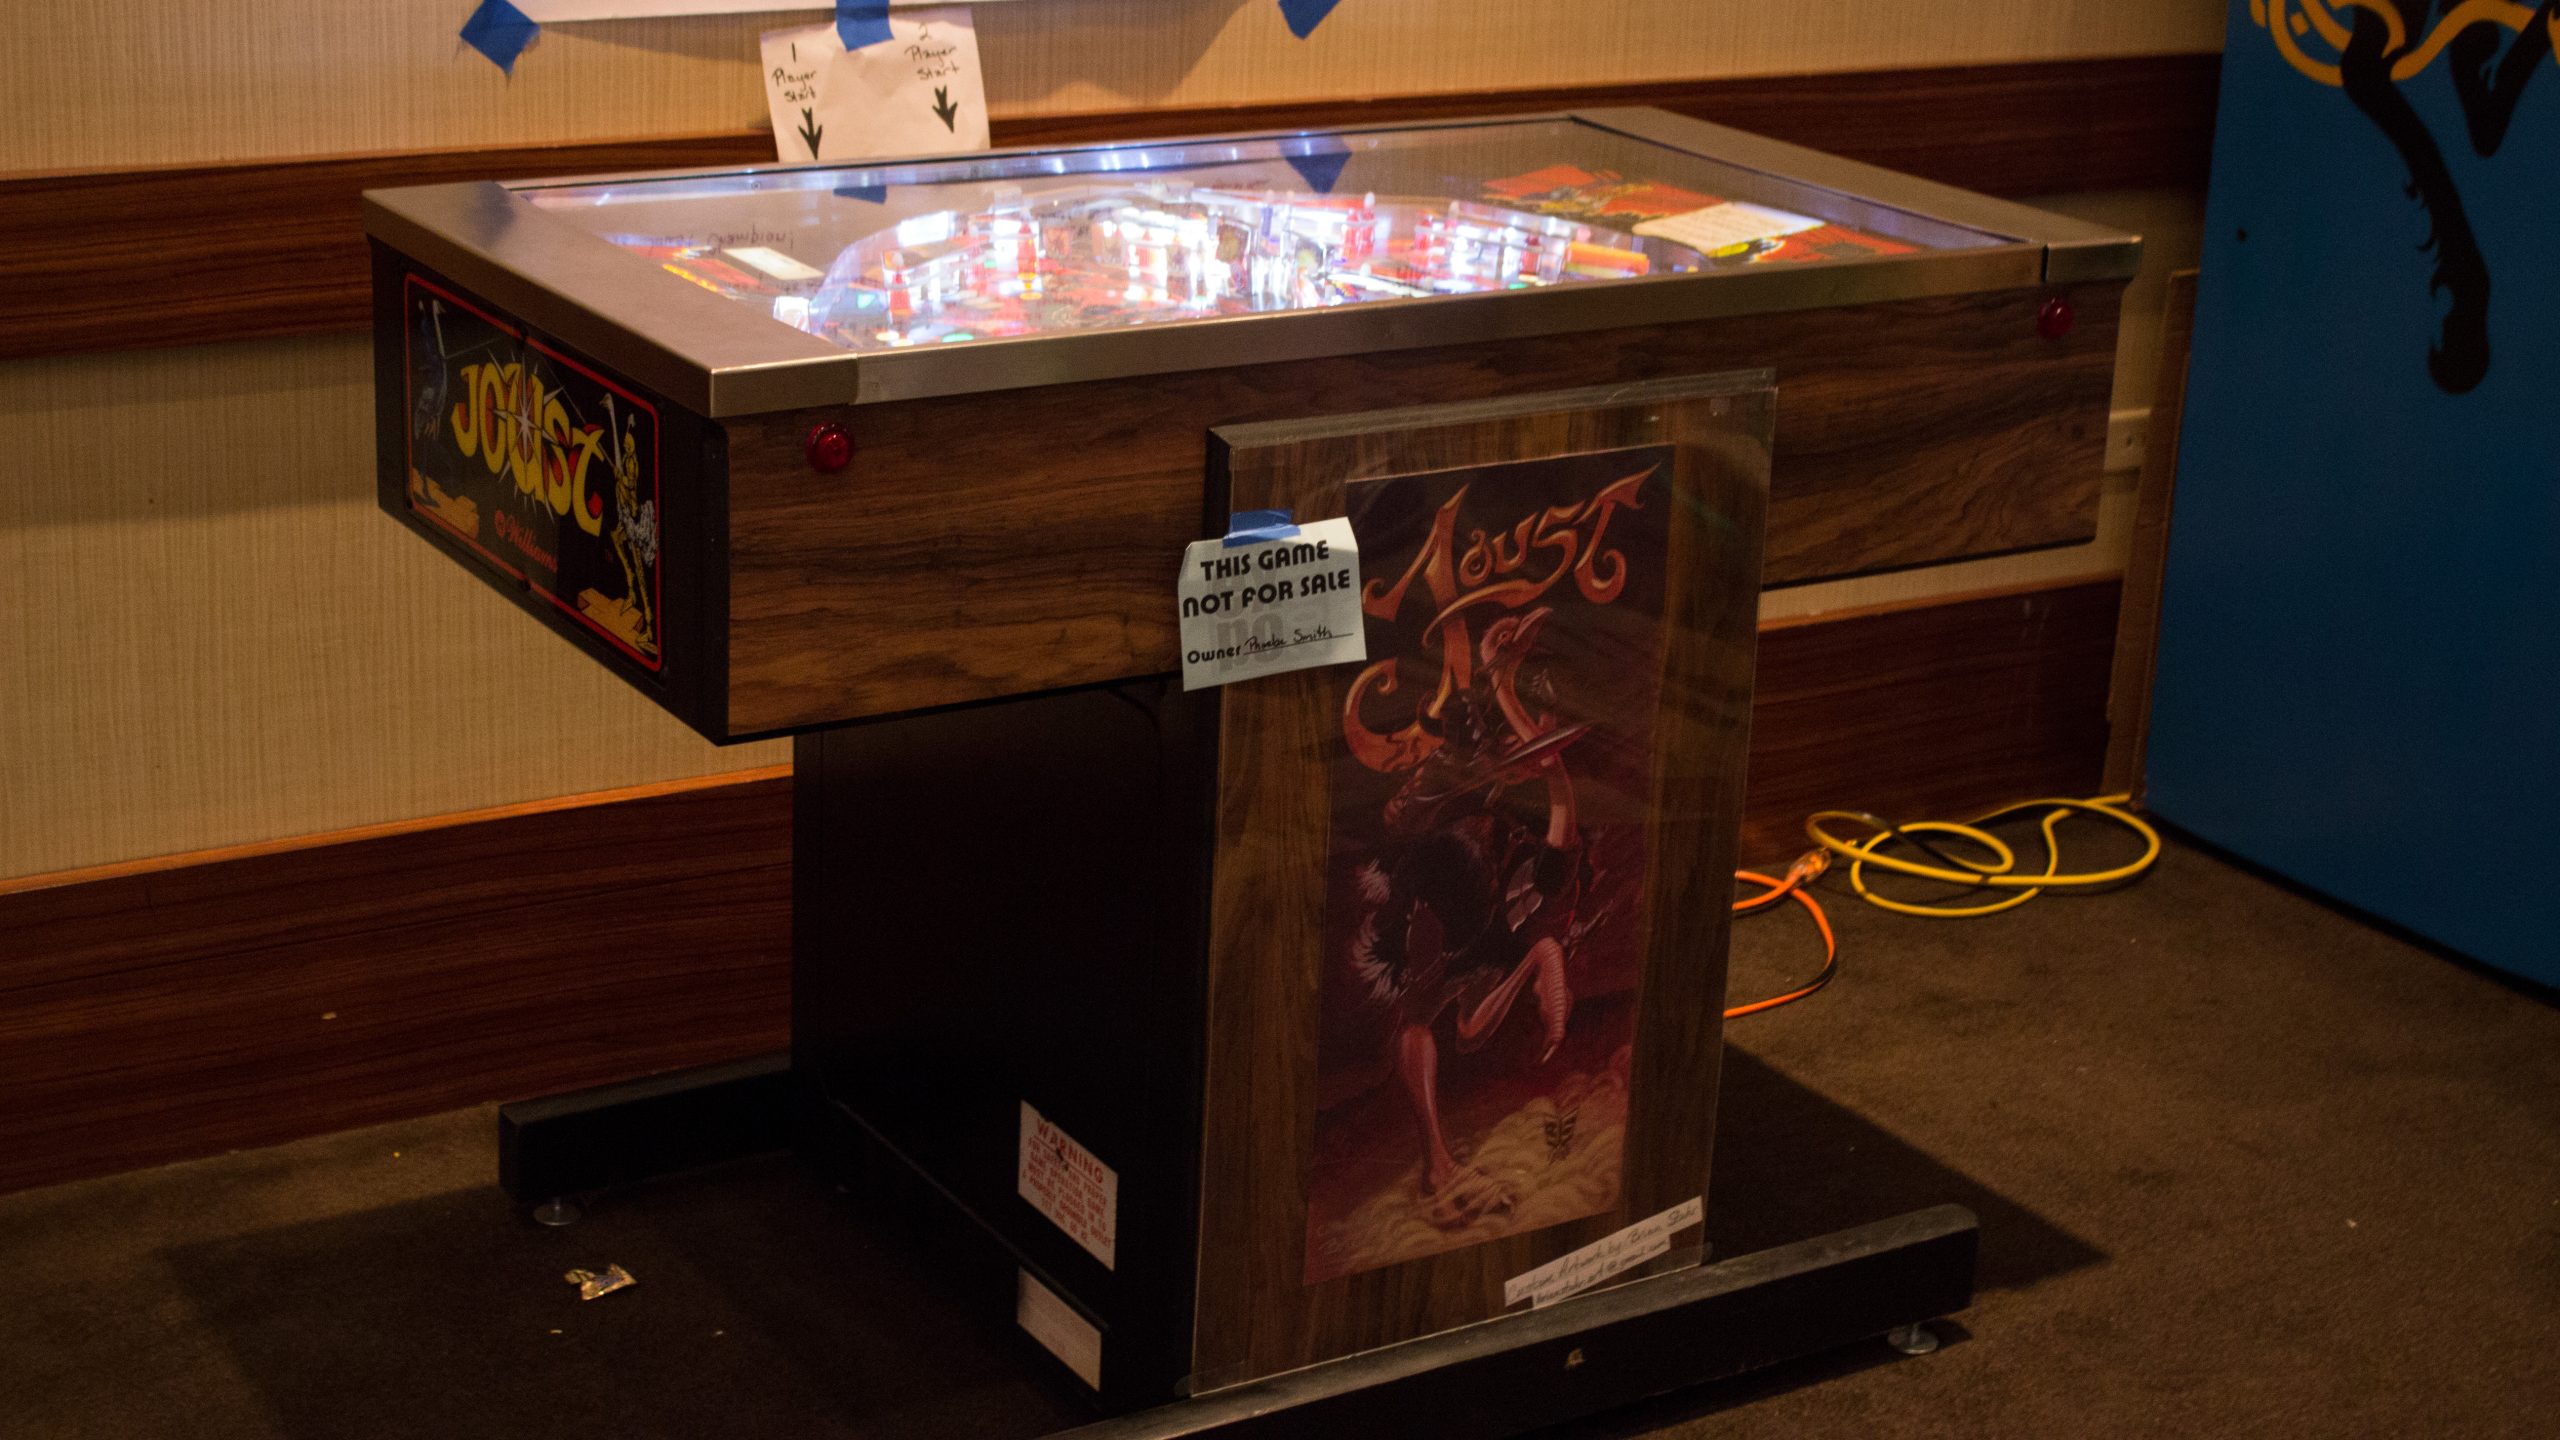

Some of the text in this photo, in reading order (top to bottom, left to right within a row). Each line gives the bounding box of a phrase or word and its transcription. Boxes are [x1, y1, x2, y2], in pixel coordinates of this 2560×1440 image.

[917, 24, 933, 41] 2
[791, 43, 797, 63] 1
[904, 45, 958, 64] Player
[771, 68, 818, 88] Player
[916, 65, 960, 80] Start
[784, 89, 817, 104] Start
[451, 361, 605, 538] JOUST
[1200, 540, 1330, 581] THIS GAME
[1183, 569, 1351, 618] NOT FOR SALE
[1187, 645, 1241, 664] Owner
[1293, 624, 1332, 643] Smith
[1036, 1118, 1104, 1184] WARNING
